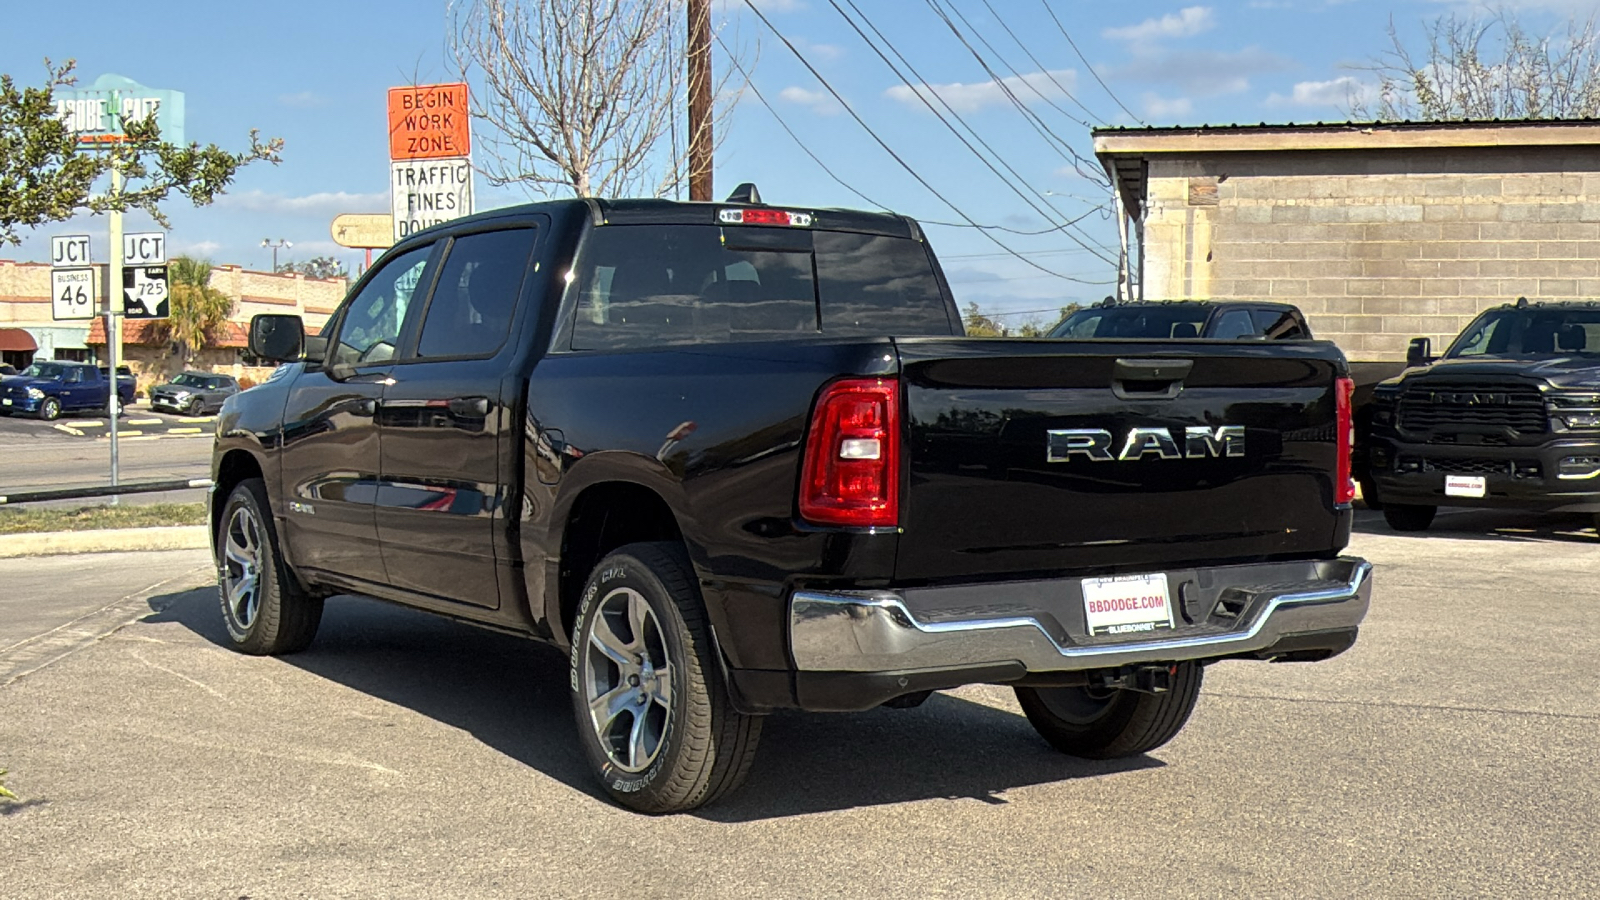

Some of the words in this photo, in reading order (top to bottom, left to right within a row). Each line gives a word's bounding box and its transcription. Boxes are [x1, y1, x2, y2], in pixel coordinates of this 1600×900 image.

[402, 91, 453, 109] BEGIN
[405, 113, 453, 131] WORK
[407, 136, 453, 153] ZONE
[396, 166, 467, 186] TRAFFIC
[408, 192, 456, 211] FINES
[55, 241, 88, 262] JCT
[126, 238, 162, 259] JCT
[57, 274, 89, 282] BUSINESS
[60, 285, 88, 305] 46
[138, 283, 163, 295] 725
[1047, 426, 1245, 462] RAM
[1088, 596, 1164, 613] BBDODGE.COM
